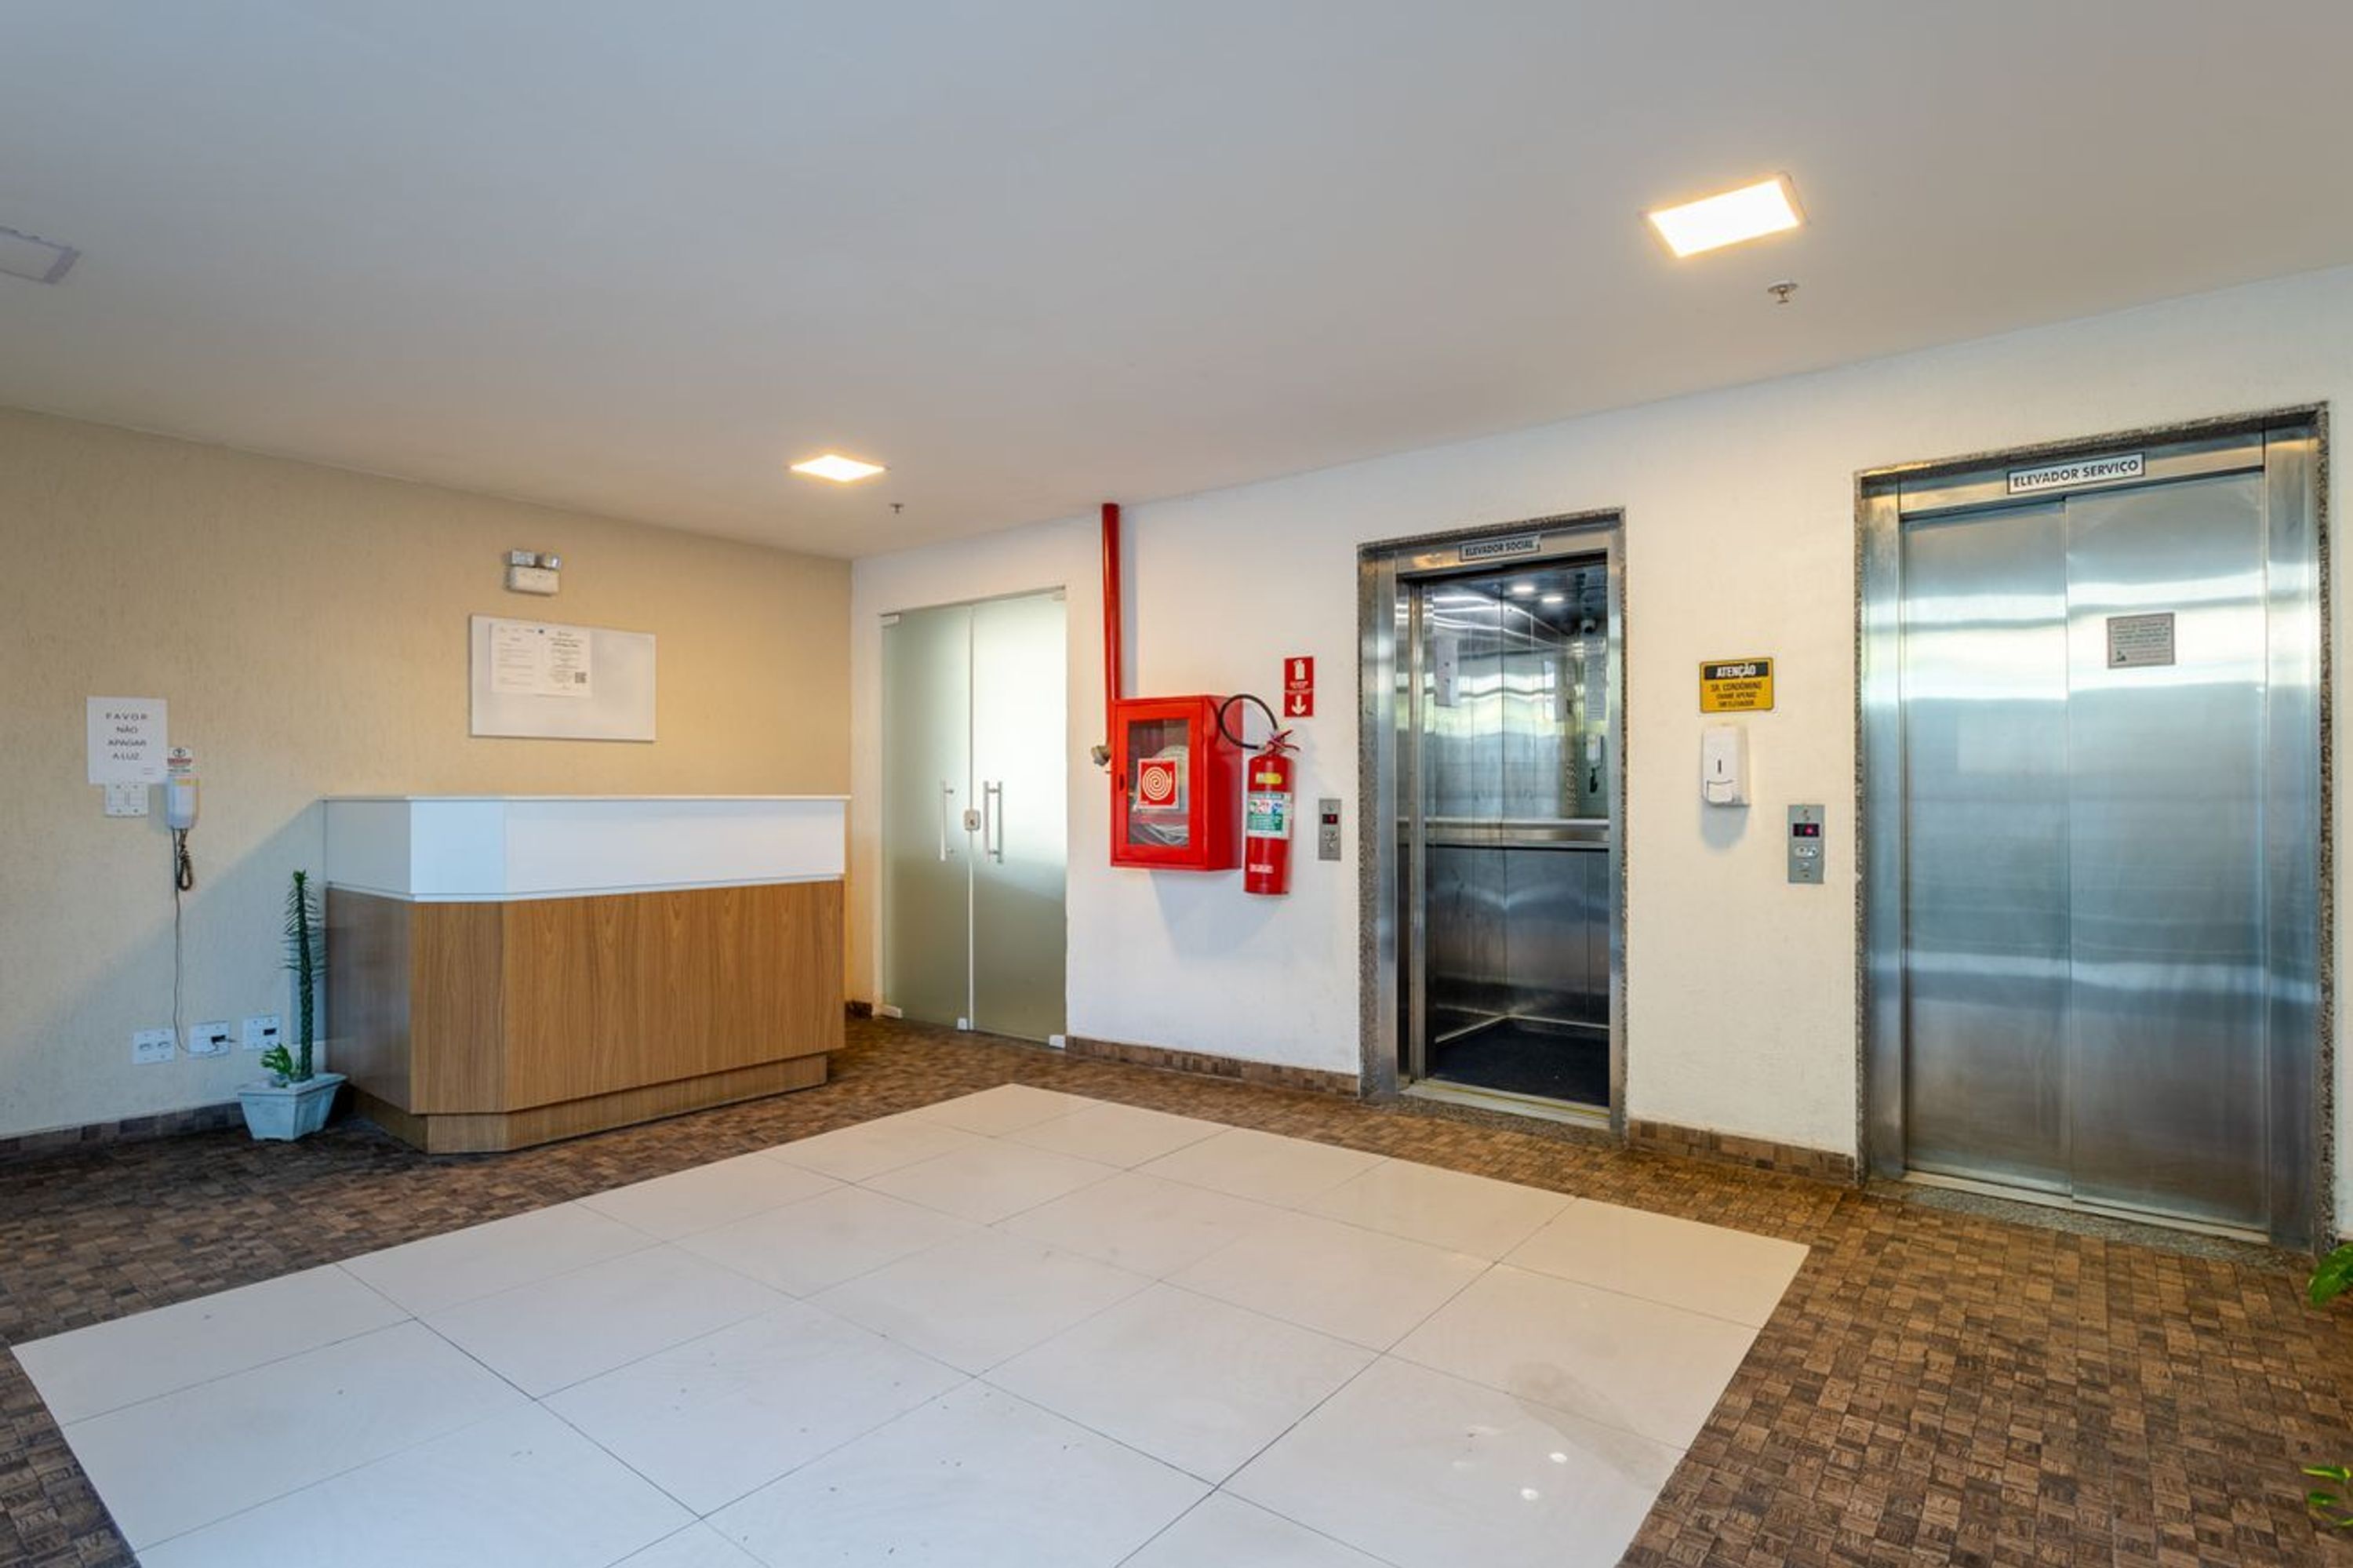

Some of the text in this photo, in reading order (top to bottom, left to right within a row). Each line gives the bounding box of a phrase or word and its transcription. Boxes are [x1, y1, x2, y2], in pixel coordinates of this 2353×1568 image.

[2013, 460, 2139, 488] ELEVADOR SERVIÇO
[1465, 539, 1533, 556] ELEVADOR SOCIAL
[1716, 663, 1757, 678] ATENÇÃO
[105, 711, 148, 721] FAVOR
[116, 724, 139, 734] NÃO
